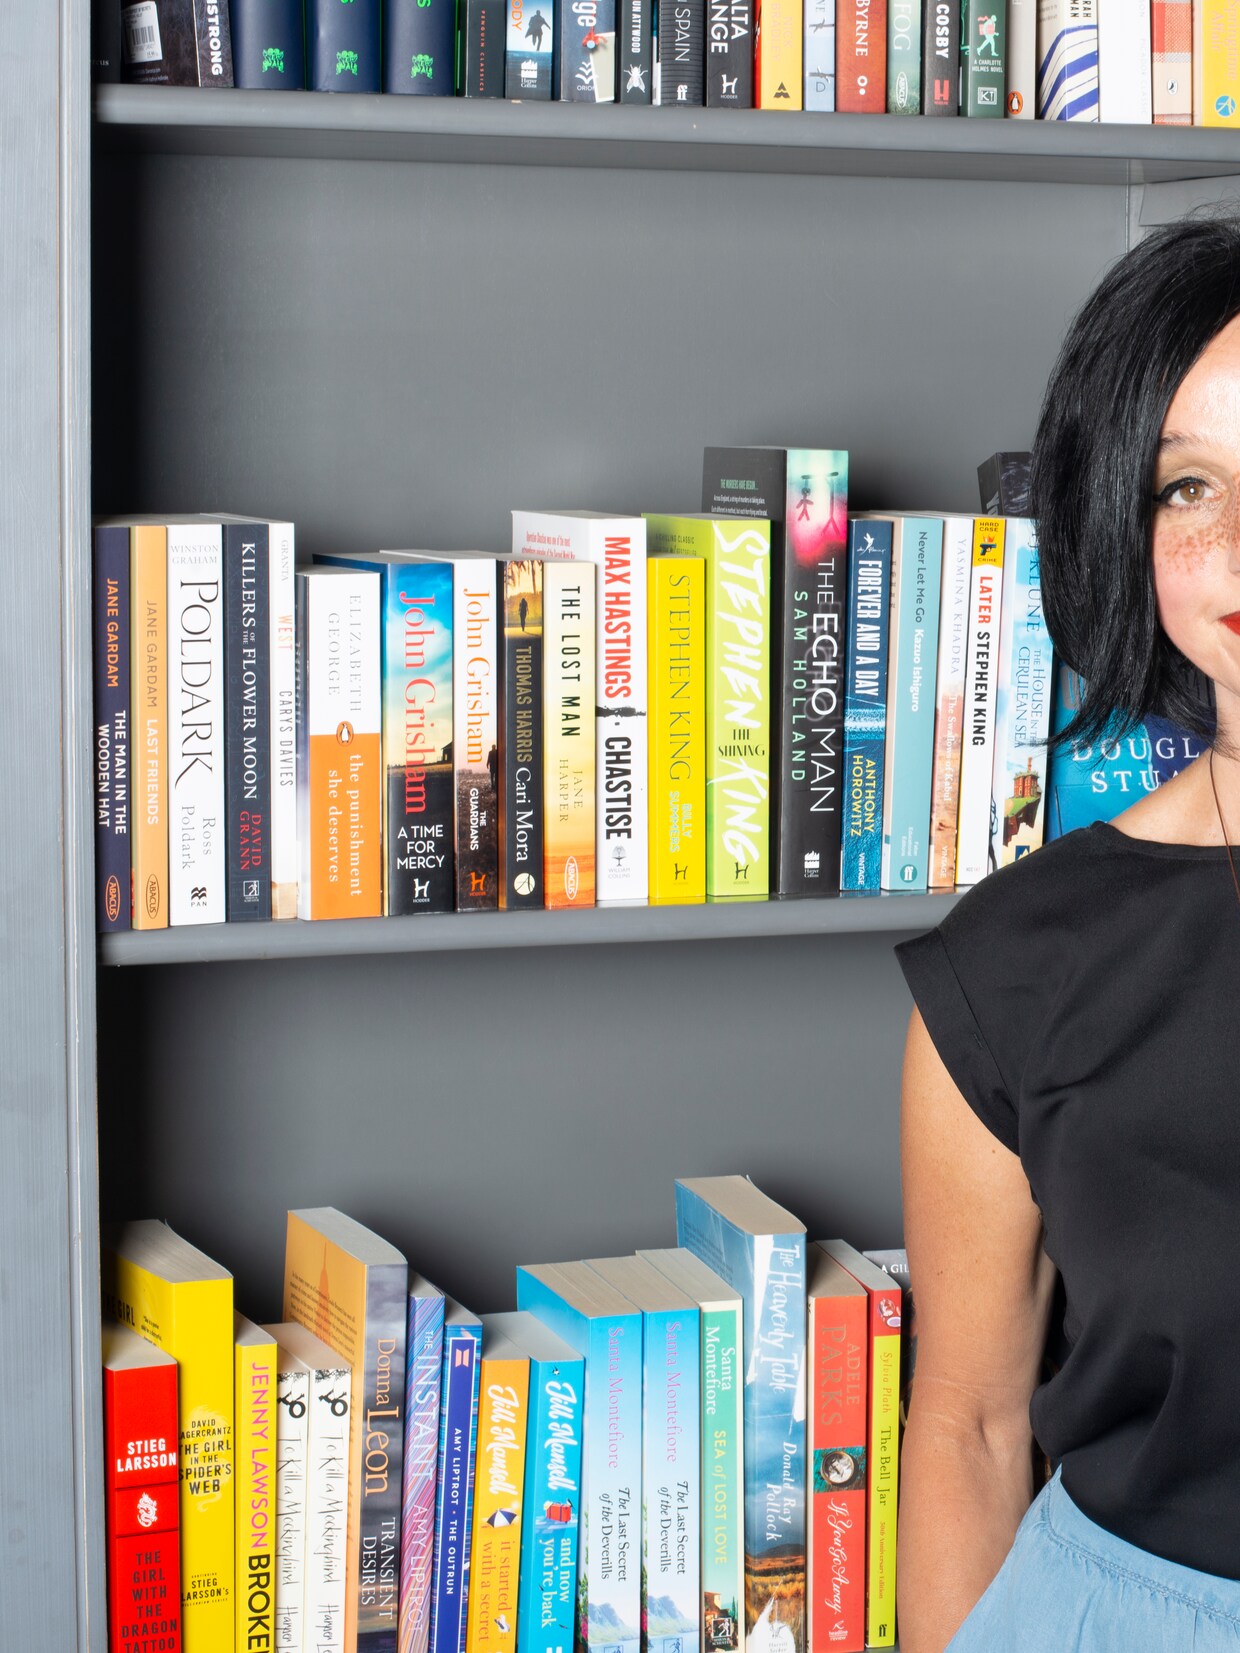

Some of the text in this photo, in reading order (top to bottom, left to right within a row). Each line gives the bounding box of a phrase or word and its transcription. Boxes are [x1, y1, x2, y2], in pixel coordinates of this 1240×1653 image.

[206, 0, 223, 76] STRONG
[631, 14, 642, 54] ATTWOOD
[675, 8, 690, 61] SPAIN
[711, 0, 728, 53] NGE
[731, 0, 748, 39] LTA
[855, 0, 870, 56] BYRNE
[893, 3, 911, 50] FOG
[935, 4, 950, 58] COSBY
[171, 545, 219, 553] WINSTON
[172, 556, 217, 564] GRAHAM
[281, 540, 289, 582] GRANTA
[242, 543, 256, 628] KILLERS
[950, 539, 967, 675] YASMINA KHADRA
[107, 578, 118, 688] JANE GARDAM
[250, 632, 256, 642] OF
[278, 614, 293, 650] WEST
[711, 520, 770, 729] STEPHEN
[855, 560, 882, 697] FOREVER AND A DAY
[909, 531, 928, 713] Never Let Me Go Kazuo Ishiguro
[328, 612, 340, 696] GEORGE
[350, 595, 362, 711] ELIZABETH
[561, 586, 580, 737] THE LOST MAN
[972, 576, 993, 746] LATER STEPHEN KING
[146, 600, 159, 825] JANE GARDAM LAST FRIENDS
[175, 579, 219, 790] POLDARK
[399, 591, 436, 815] John Grisham
[810, 558, 838, 812] THE ECHO MAN
[1014, 646, 1030, 749] CERULEAN SEA
[242, 648, 257, 799] FLOWER MOON
[279, 691, 293, 787] CARYS DAVIES
[718, 744, 765, 757] SHINING
[733, 729, 750, 740] THE
[1072, 737, 1200, 761] DOUGL
[98, 724, 110, 828] WOODEN HAT
[114, 710, 127, 835] THE MAN IN THE
[559, 759, 569, 822] HARPER
[573, 770, 583, 809] JANE
[850, 755, 863, 837] HOROWITZ
[864, 759, 876, 833] ANTHONY
[181, 805, 195, 870] Poldark
[202, 817, 216, 855] Ross
[240, 811, 250, 871] GRANN
[251, 814, 262, 866] DAVID
[328, 770, 343, 883] she deserves
[346, 754, 364, 897] the punishment
[397, 824, 444, 839] A TIME
[706, 758, 768, 866] KING
[396, 855, 445, 870] MERCY
[406, 840, 435, 853] FOR
[857, 852, 865, 885] VINTAGE
[940, 845, 948, 878] VINTAGE
[109, 881, 117, 916] ABACUS
[608, 1327, 625, 1469] Santa Montefiore
[705, 1326, 720, 1415] Montefiore
[721, 1347, 735, 1391] Santa
[880, 1351, 892, 1413] Sylvia Plath
[127, 1438, 166, 1455] STIEG
[179, 1427, 231, 1440] AGERCRANTZ
[191, 1419, 216, 1428] DAVID
[365, 1338, 399, 1497] Donna Leon
[117, 1452, 177, 1472] LARSSON
[179, 1440, 231, 1456] THE GIRL
[179, 1463, 231, 1481] SPIDER'S
[190, 1455, 218, 1465] IN THE
[189, 1479, 220, 1495] WEB
[247, 1362, 270, 1653] JENNY LAWSON BROKE
[446, 1428, 462, 1595] AMY LIPTROT THE OUTRUN
[766, 1483, 782, 1542] Pollock
[778, 1441, 797, 1525] Donald Ray
[136, 1551, 161, 1566] THE
[599, 1493, 613, 1580] of the Deverills
[618, 1487, 631, 1582] The Last Secret
[824, 1497, 853, 1614] If You Go Away
[132, 1569, 165, 1584] GIRL
[132, 1585, 167, 1601] WITH
[191, 1578, 218, 1589] STIEG
[361, 1536, 377, 1606] DESIRES
[379, 1517, 396, 1620] TRANSIENT
[478, 1541, 496, 1642] with a secret
[498, 1541, 515, 1612] it started
[121, 1618, 177, 1639] DRAGON
[136, 1603, 162, 1618] THE
[124, 1637, 175, 1653] TATTOO
